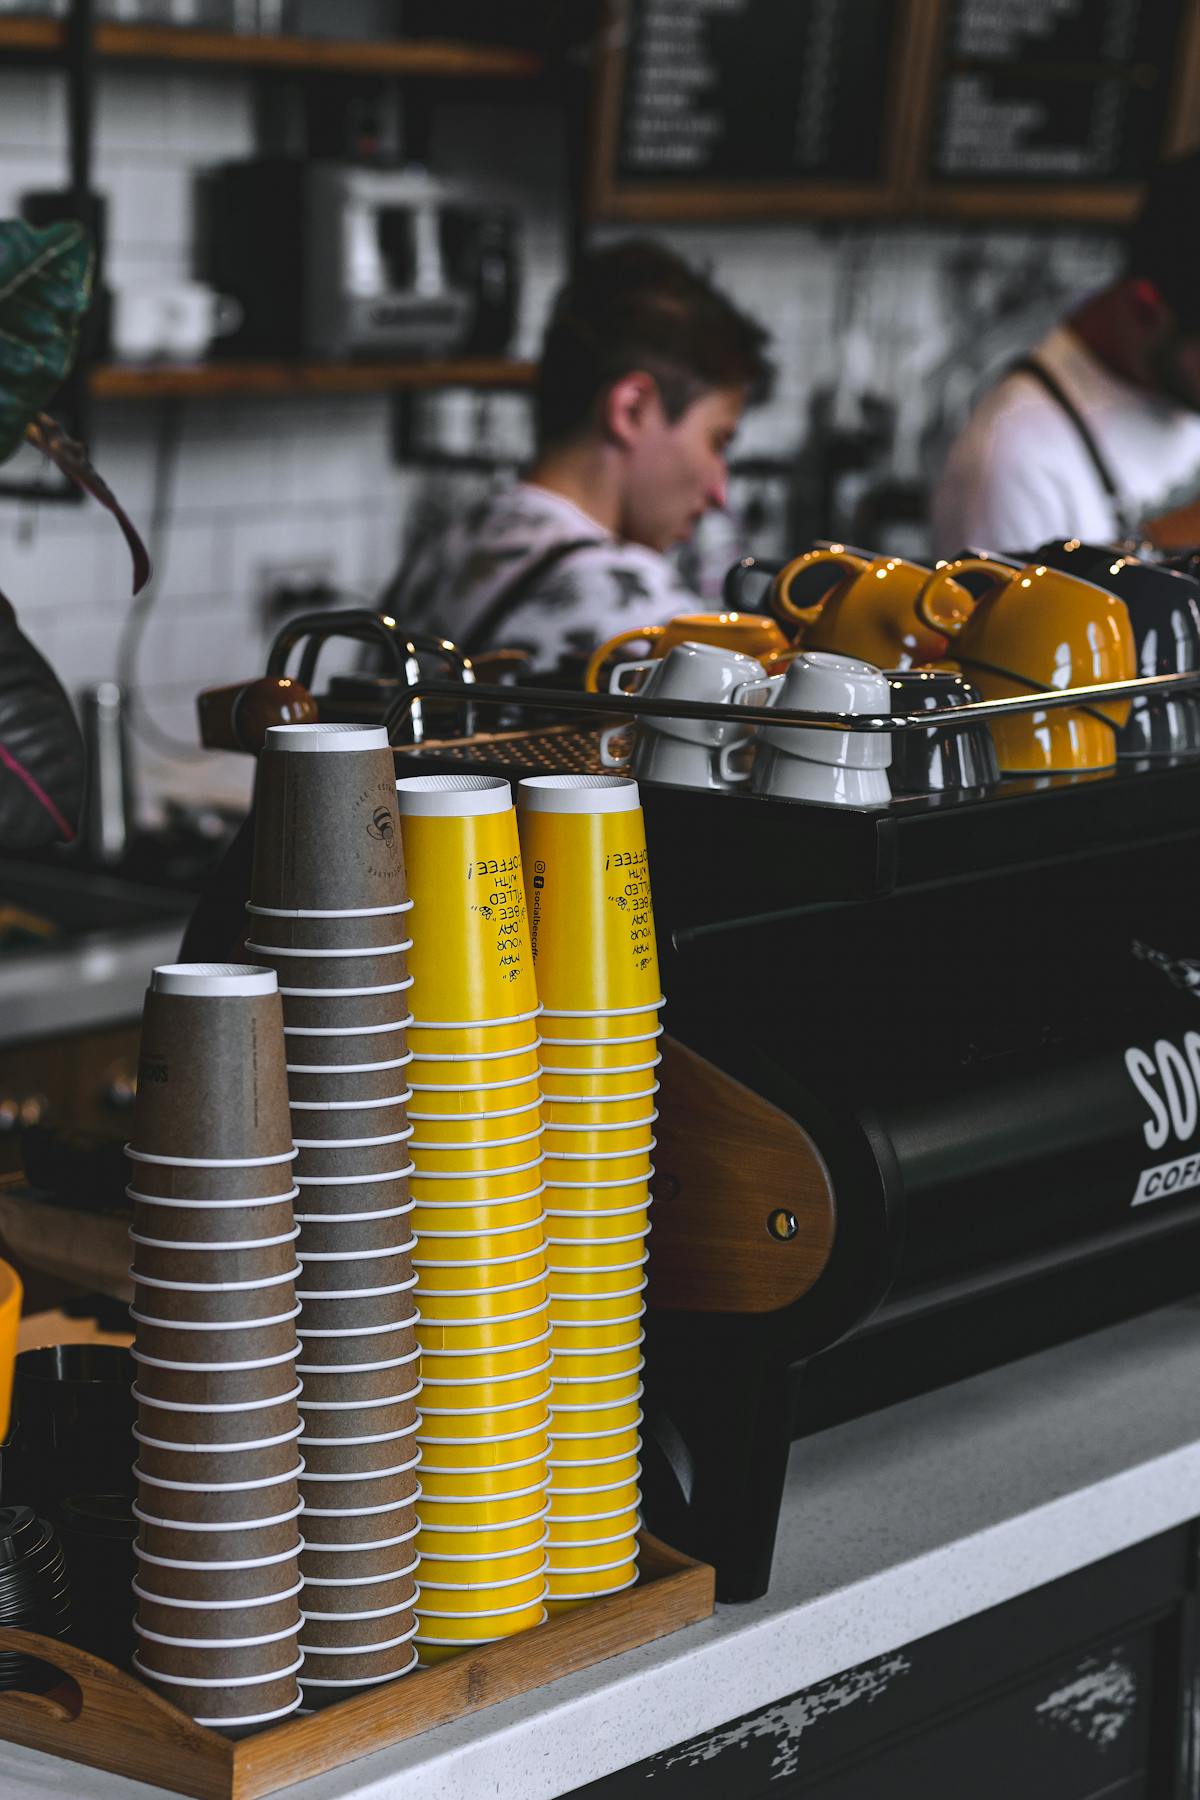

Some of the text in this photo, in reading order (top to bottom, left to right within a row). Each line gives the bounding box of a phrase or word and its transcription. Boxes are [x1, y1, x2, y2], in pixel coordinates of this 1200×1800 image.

[632, 897, 648, 910] BEE
[499, 905, 519, 919] BEE
[632, 913, 648, 925] DAY
[499, 922, 518, 935] DAY
[497, 938, 522, 950] YOUR
[633, 943, 648, 954] MAY
[500, 953, 520, 966] MAY
